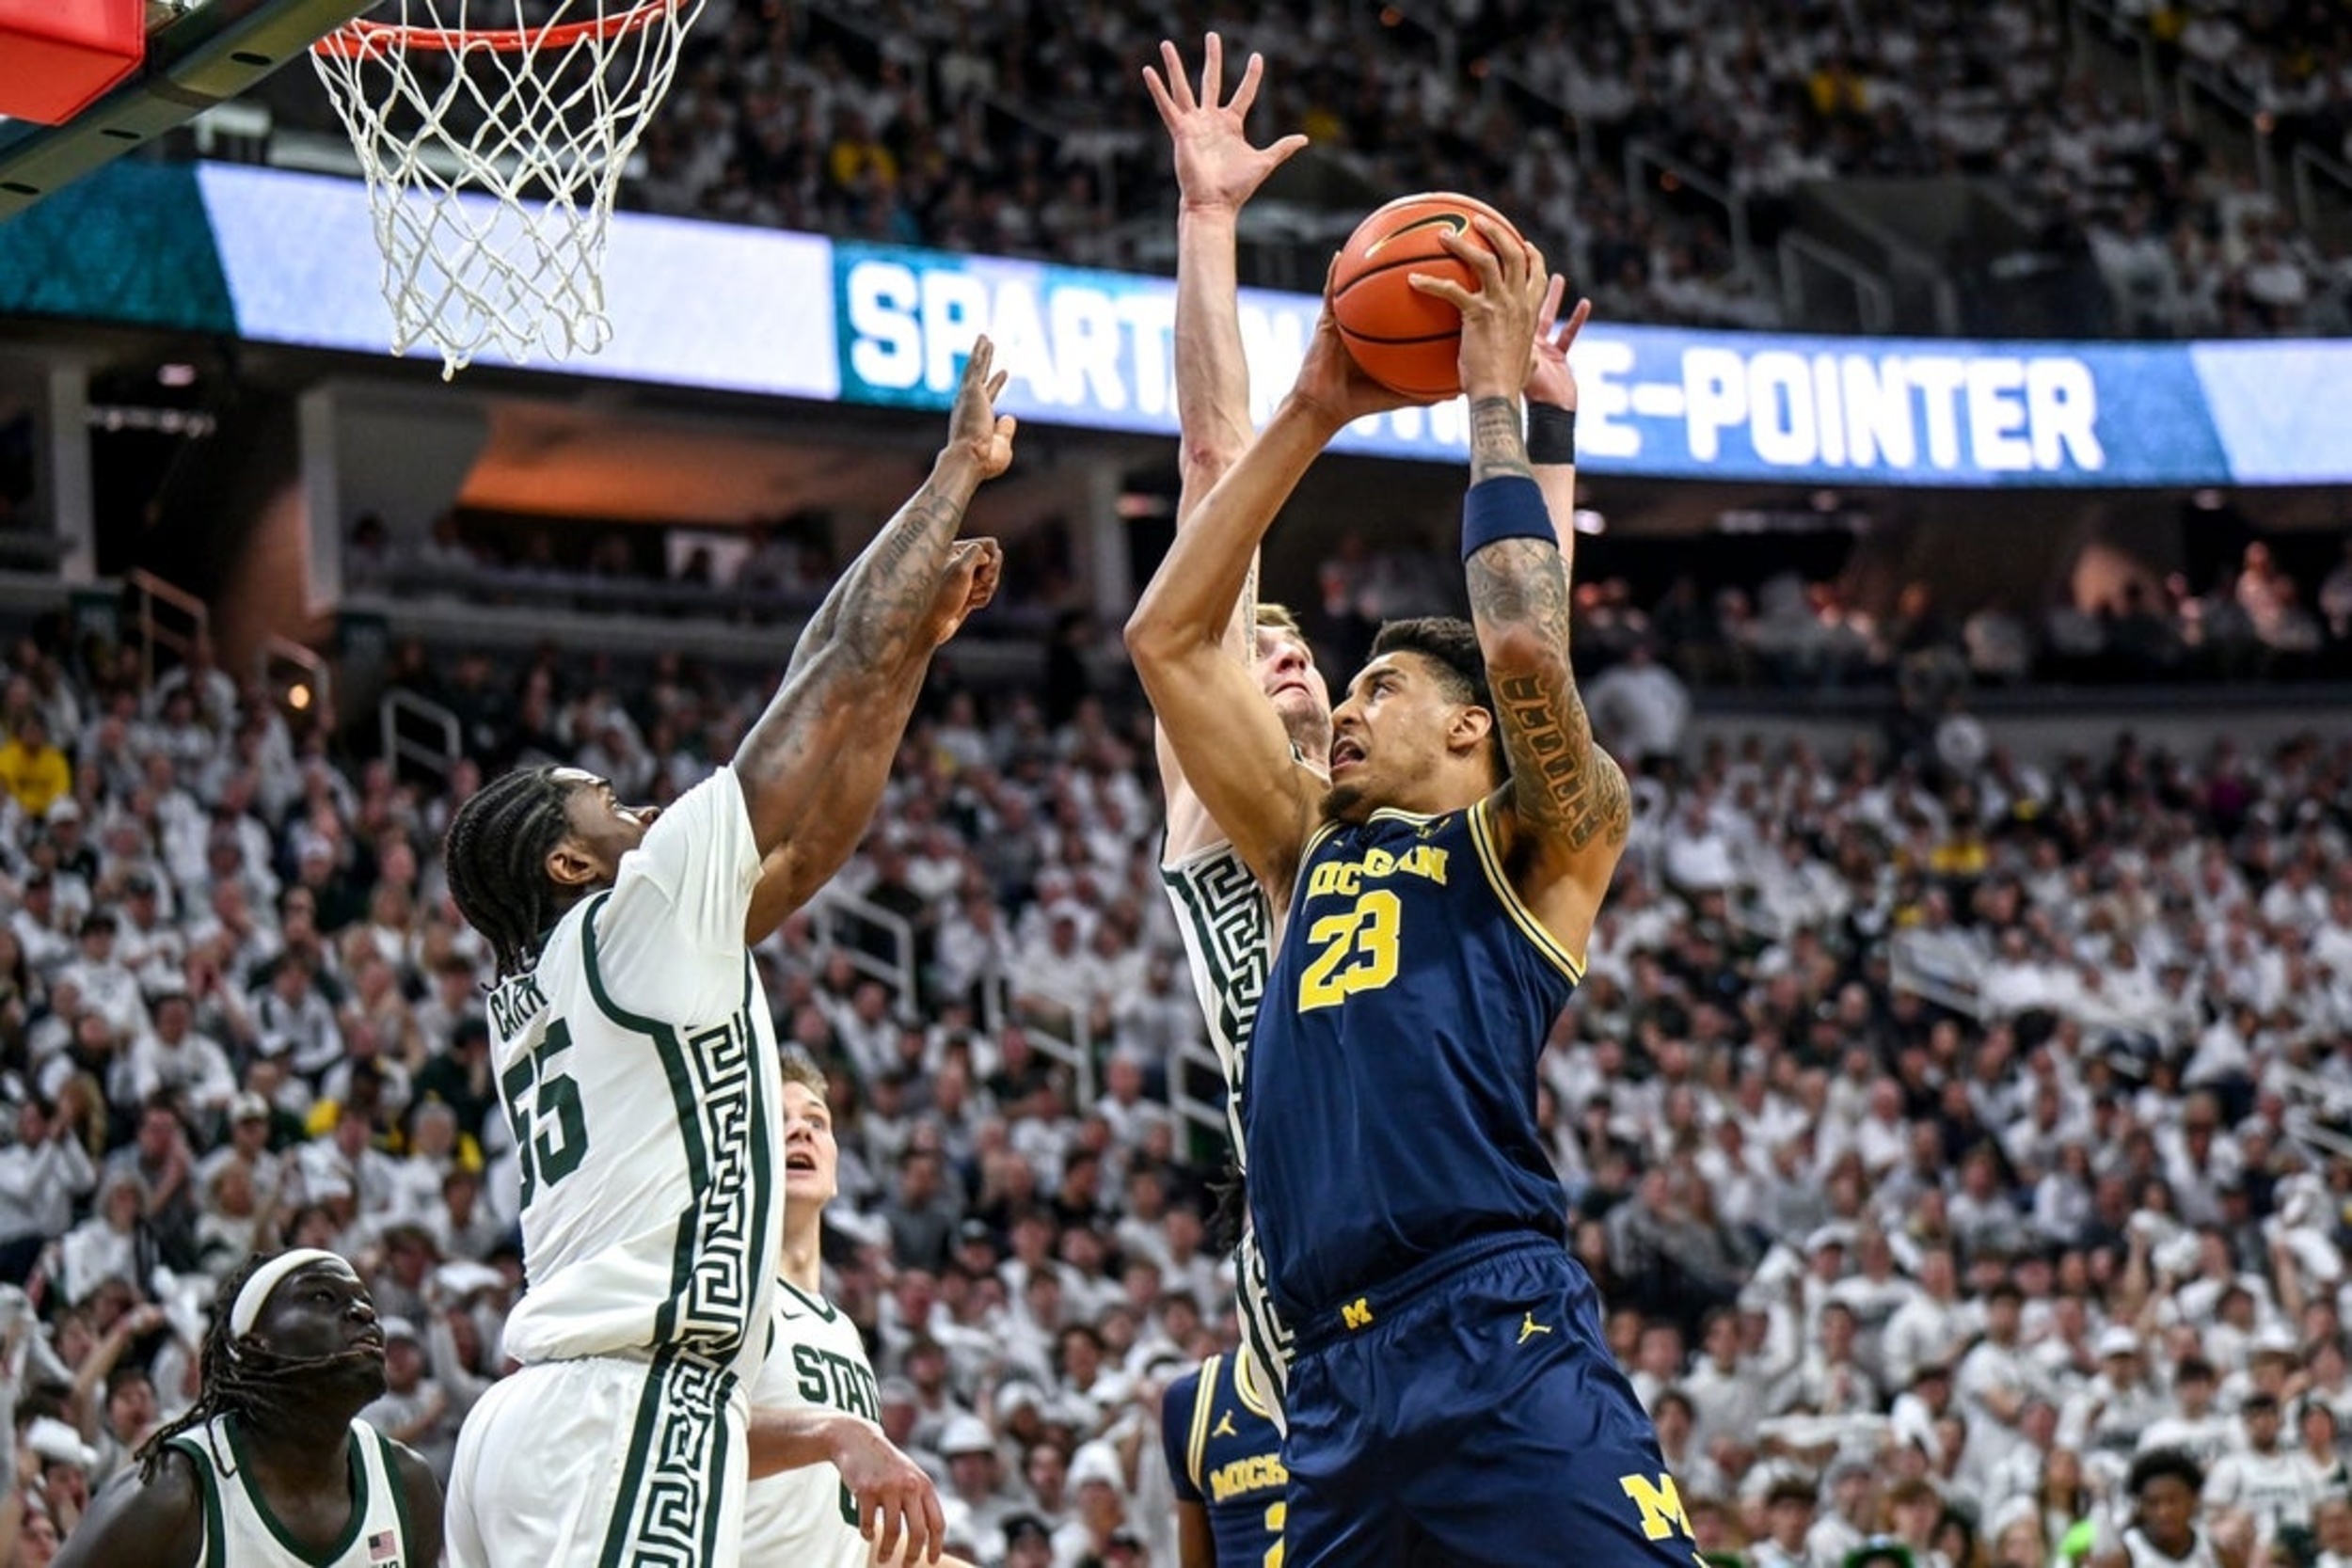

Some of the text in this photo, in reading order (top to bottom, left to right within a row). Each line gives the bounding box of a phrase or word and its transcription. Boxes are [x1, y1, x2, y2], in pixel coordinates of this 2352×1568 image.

[847, 260, 2106, 470] SPARTN E-POINTER
[1296, 888, 1403, 1013] 23
[501, 1015, 590, 1212] 55
[1341, 1297, 1374, 1329] M
[1619, 1472, 1696, 1541] M
